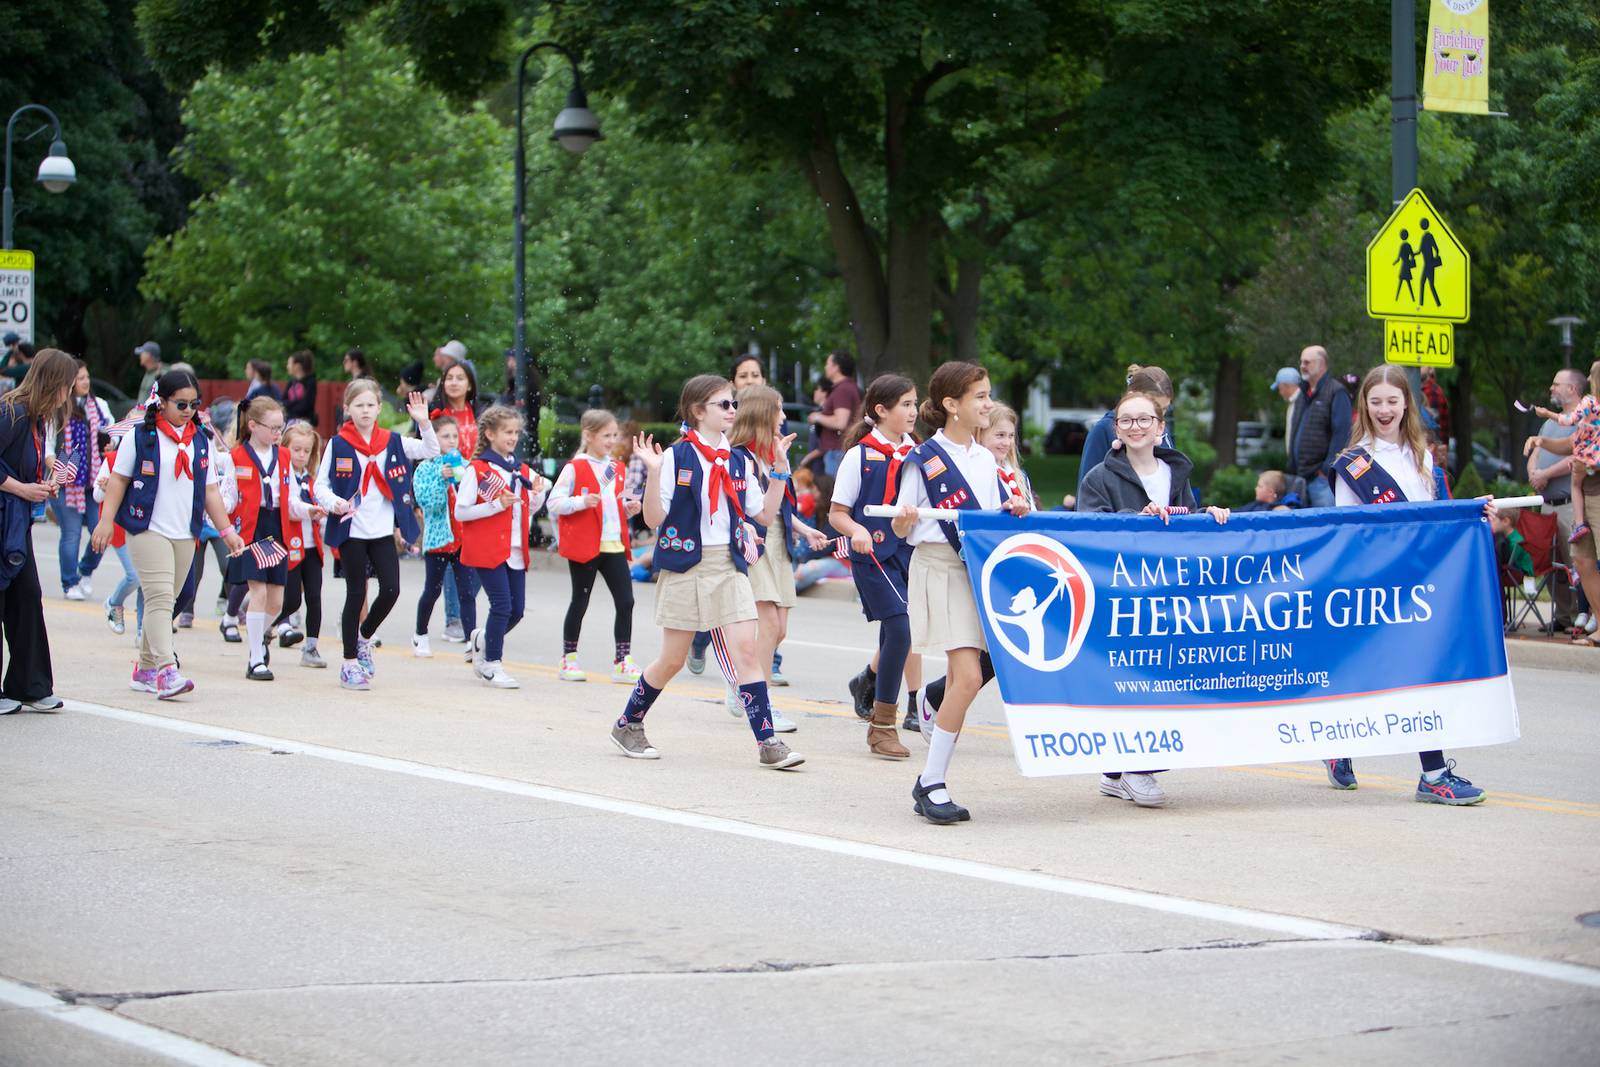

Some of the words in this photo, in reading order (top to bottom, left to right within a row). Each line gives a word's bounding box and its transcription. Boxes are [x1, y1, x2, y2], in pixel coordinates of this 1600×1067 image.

[1433, 27, 1485, 54] Enriching
[1433, 48, 1459, 75] Your
[0, 274, 29, 286] PEED
[0, 287, 25, 297] IMIT
[1388, 330, 1450, 355] AHEAD
[1377, 490, 1396, 504] 248
[1110, 552, 1305, 588] AMERICAN
[1106, 590, 1313, 638] HERITAGE
[1106, 649, 1162, 667] FAITH
[1177, 645, 1247, 665] SERVICE
[1260, 642, 1293, 661] FUN
[1113, 668, 1330, 694] www.americanheritagegirls.org
[1277, 722, 1305, 744] St.
[1309, 717, 1381, 742] Patrick
[1384, 709, 1444, 734] Parish
[1025, 732, 1107, 758] TROOP
[1113, 729, 1184, 754] IL1248
